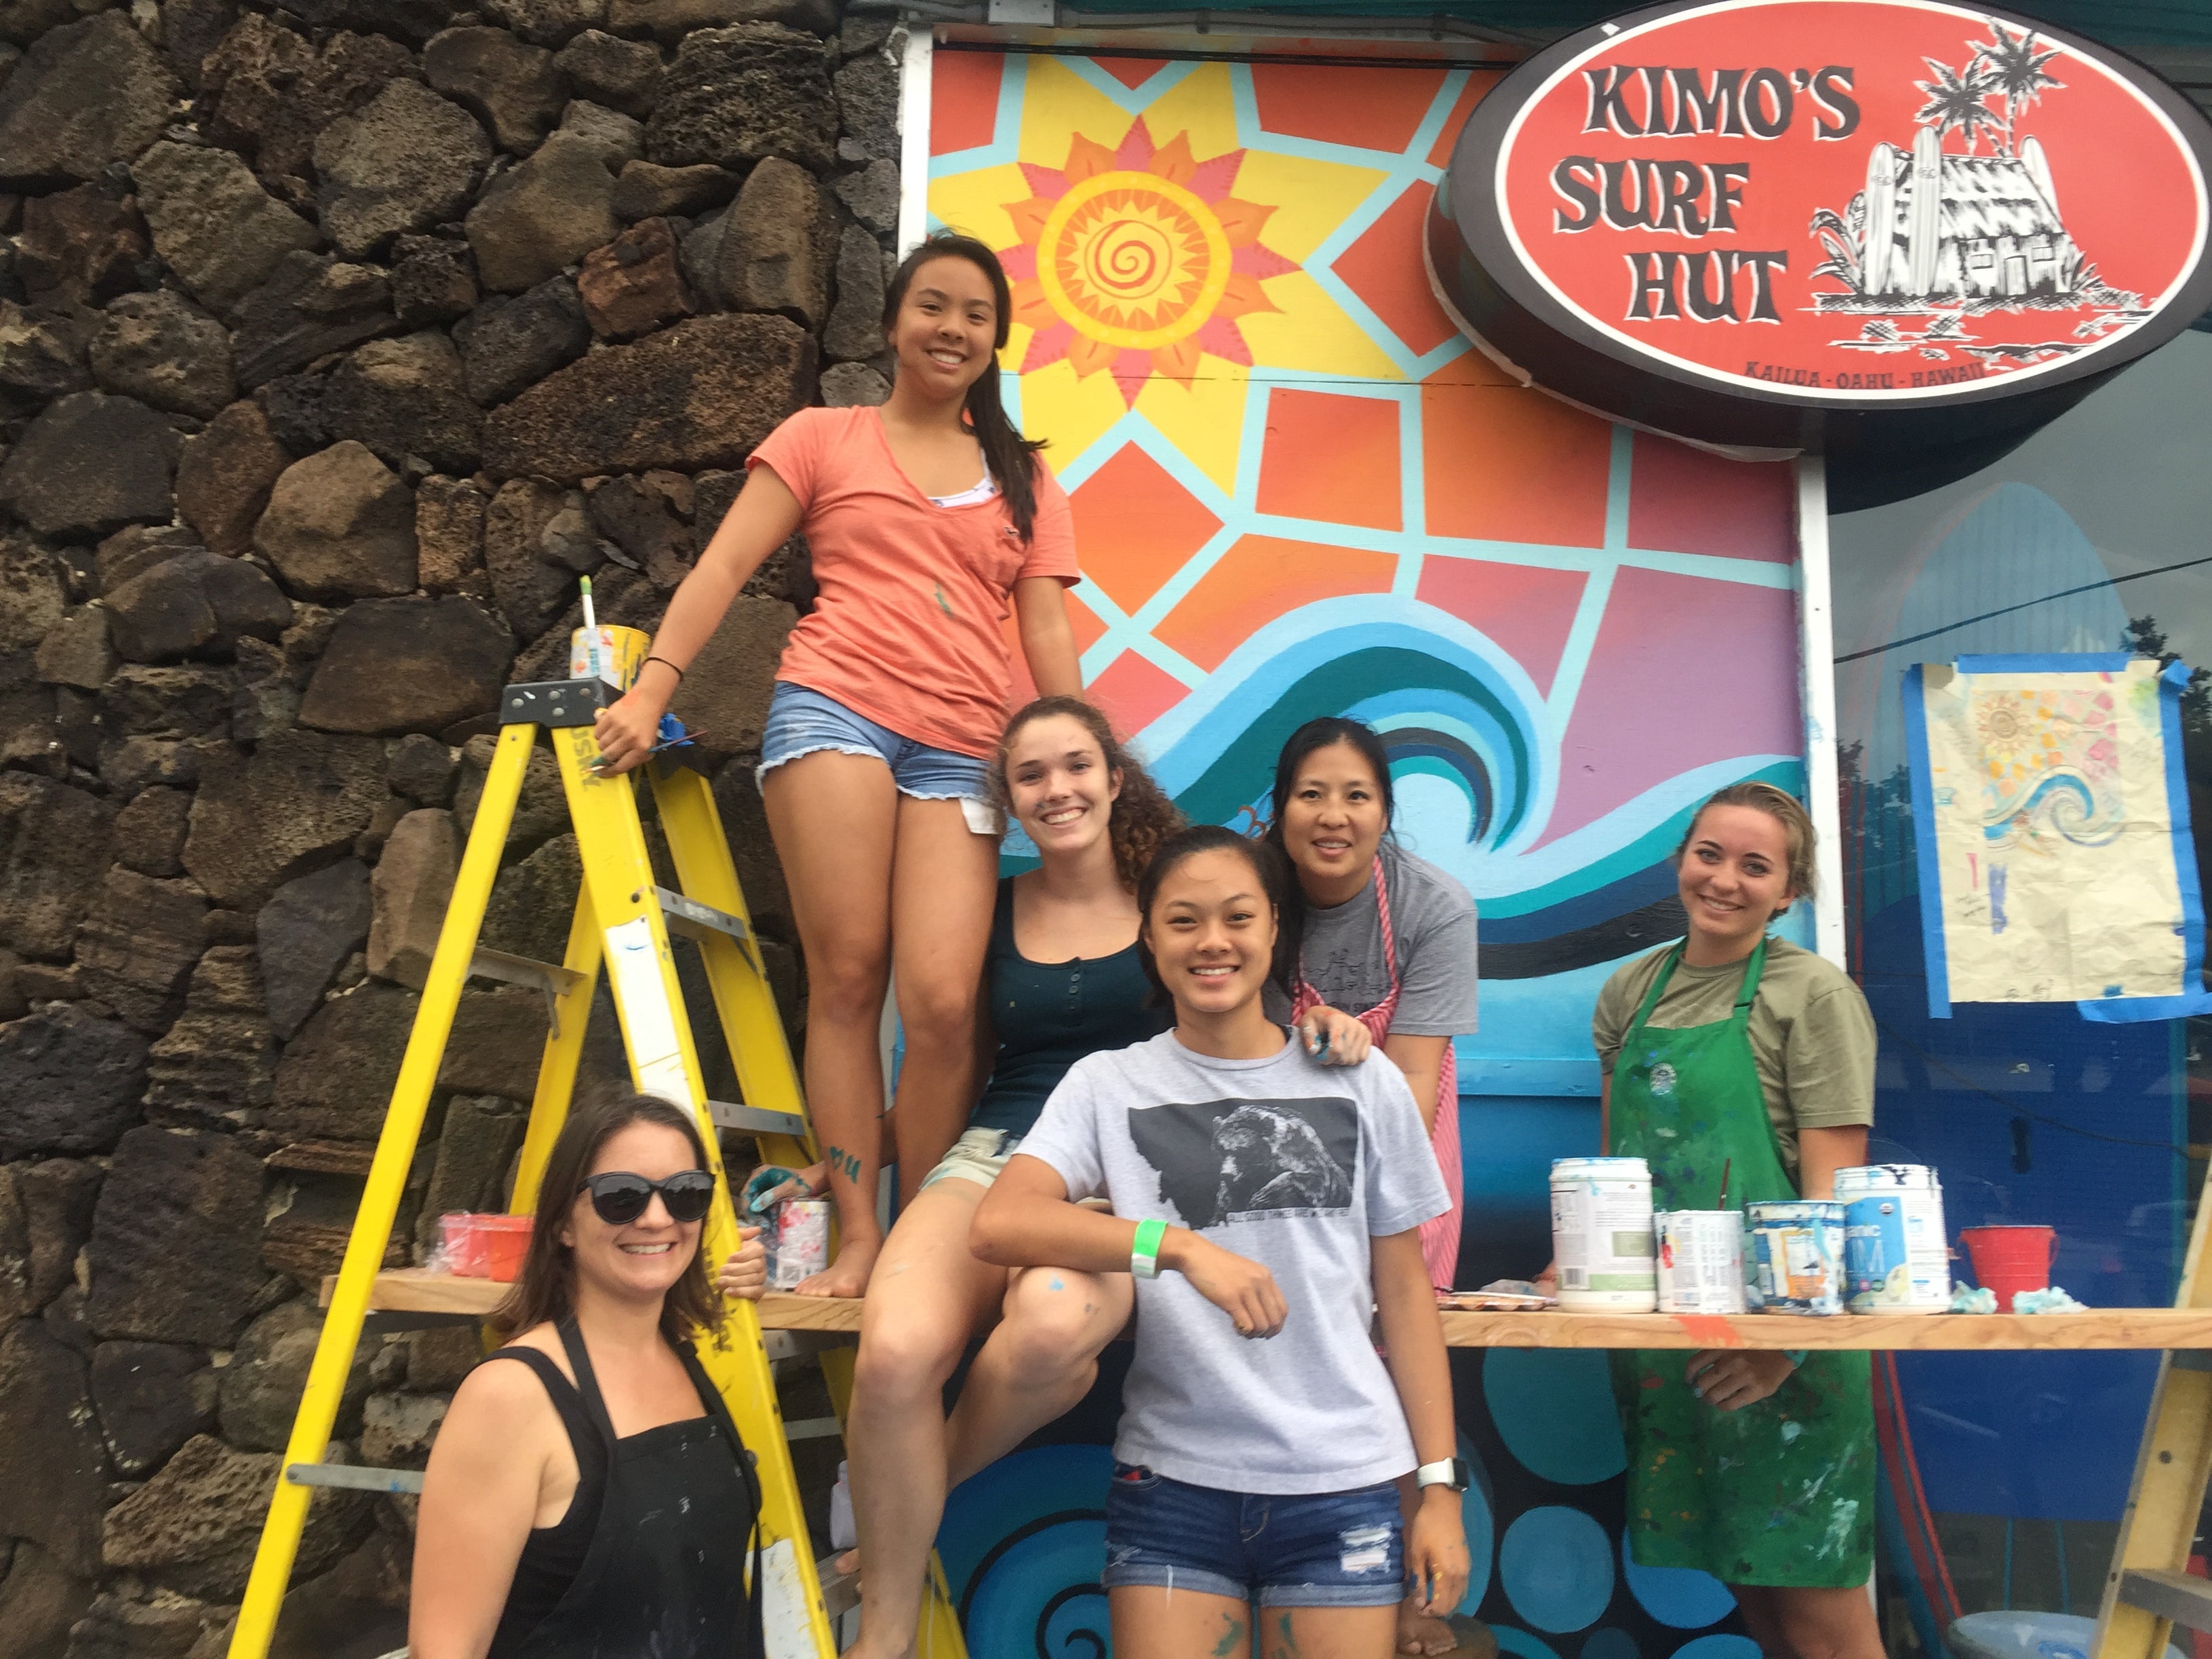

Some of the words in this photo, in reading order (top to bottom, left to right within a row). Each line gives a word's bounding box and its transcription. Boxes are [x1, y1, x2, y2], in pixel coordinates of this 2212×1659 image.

[1581, 64, 1860, 141] KIMO'S
[1549, 155, 1750, 239] SURF
[1623, 249, 1788, 325] HUT
[1744, 361, 1821, 388] KAILUA
[1836, 372, 1893, 390] OAHU
[1910, 361, 1986, 388] HAWAII
